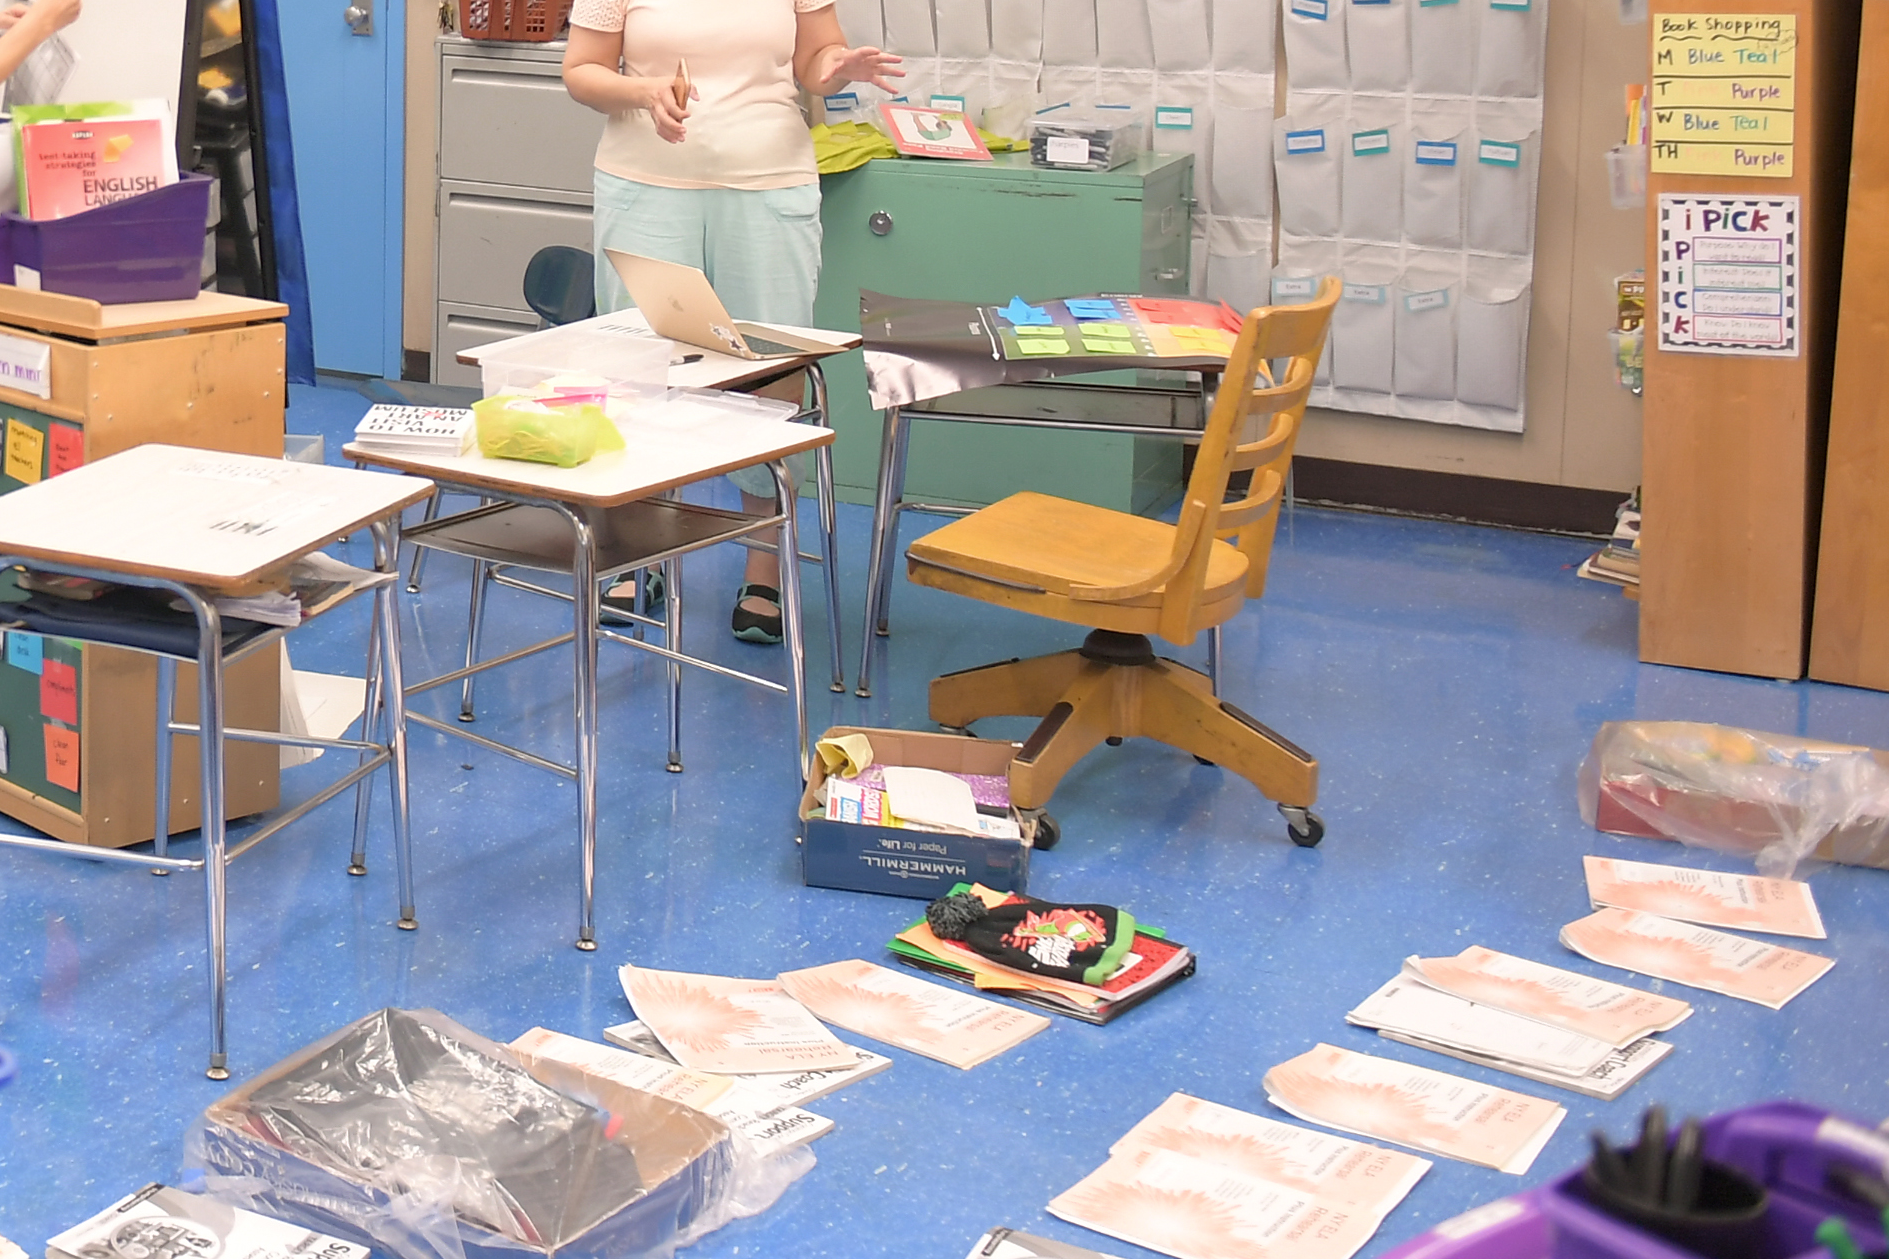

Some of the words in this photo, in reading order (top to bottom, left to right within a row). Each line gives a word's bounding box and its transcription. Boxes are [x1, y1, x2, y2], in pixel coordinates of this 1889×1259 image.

[1662, 18, 1699, 33] Book
[1706, 17, 1781, 38] Shopping
[1657, 49, 1673, 65] M
[1688, 48, 1725, 65] Blue
[1733, 48, 1778, 64] Teal
[1655, 81, 1673, 96] T
[1732, 83, 1781, 101] Purple
[1656, 111, 1674, 123] W
[1683, 113, 1720, 131] Blue
[1729, 114, 1768, 131] Teal
[1654, 143, 1678, 159] TH
[1734, 149, 1785, 169] Purple
[84, 177, 158, 193] ENGLISH
[1675, 241, 1690, 260] P
[375, 405, 467, 416] MUSEUM
[372, 418, 423, 426] VISIT
[918, 845, 947, 855] Paper
[759, 1044, 832, 1055] Rehearsal
[780, 1071, 827, 1090] Coach
[753, 1113, 815, 1140] Support
[1293, 1200, 1305, 1211] Plus
[1263, 1208, 1298, 1238] Instruction
[1286, 1206, 1329, 1242] Rehearsal
[1334, 1212, 1349, 1226] NY
[1315, 1222, 1337, 1240] ELA
